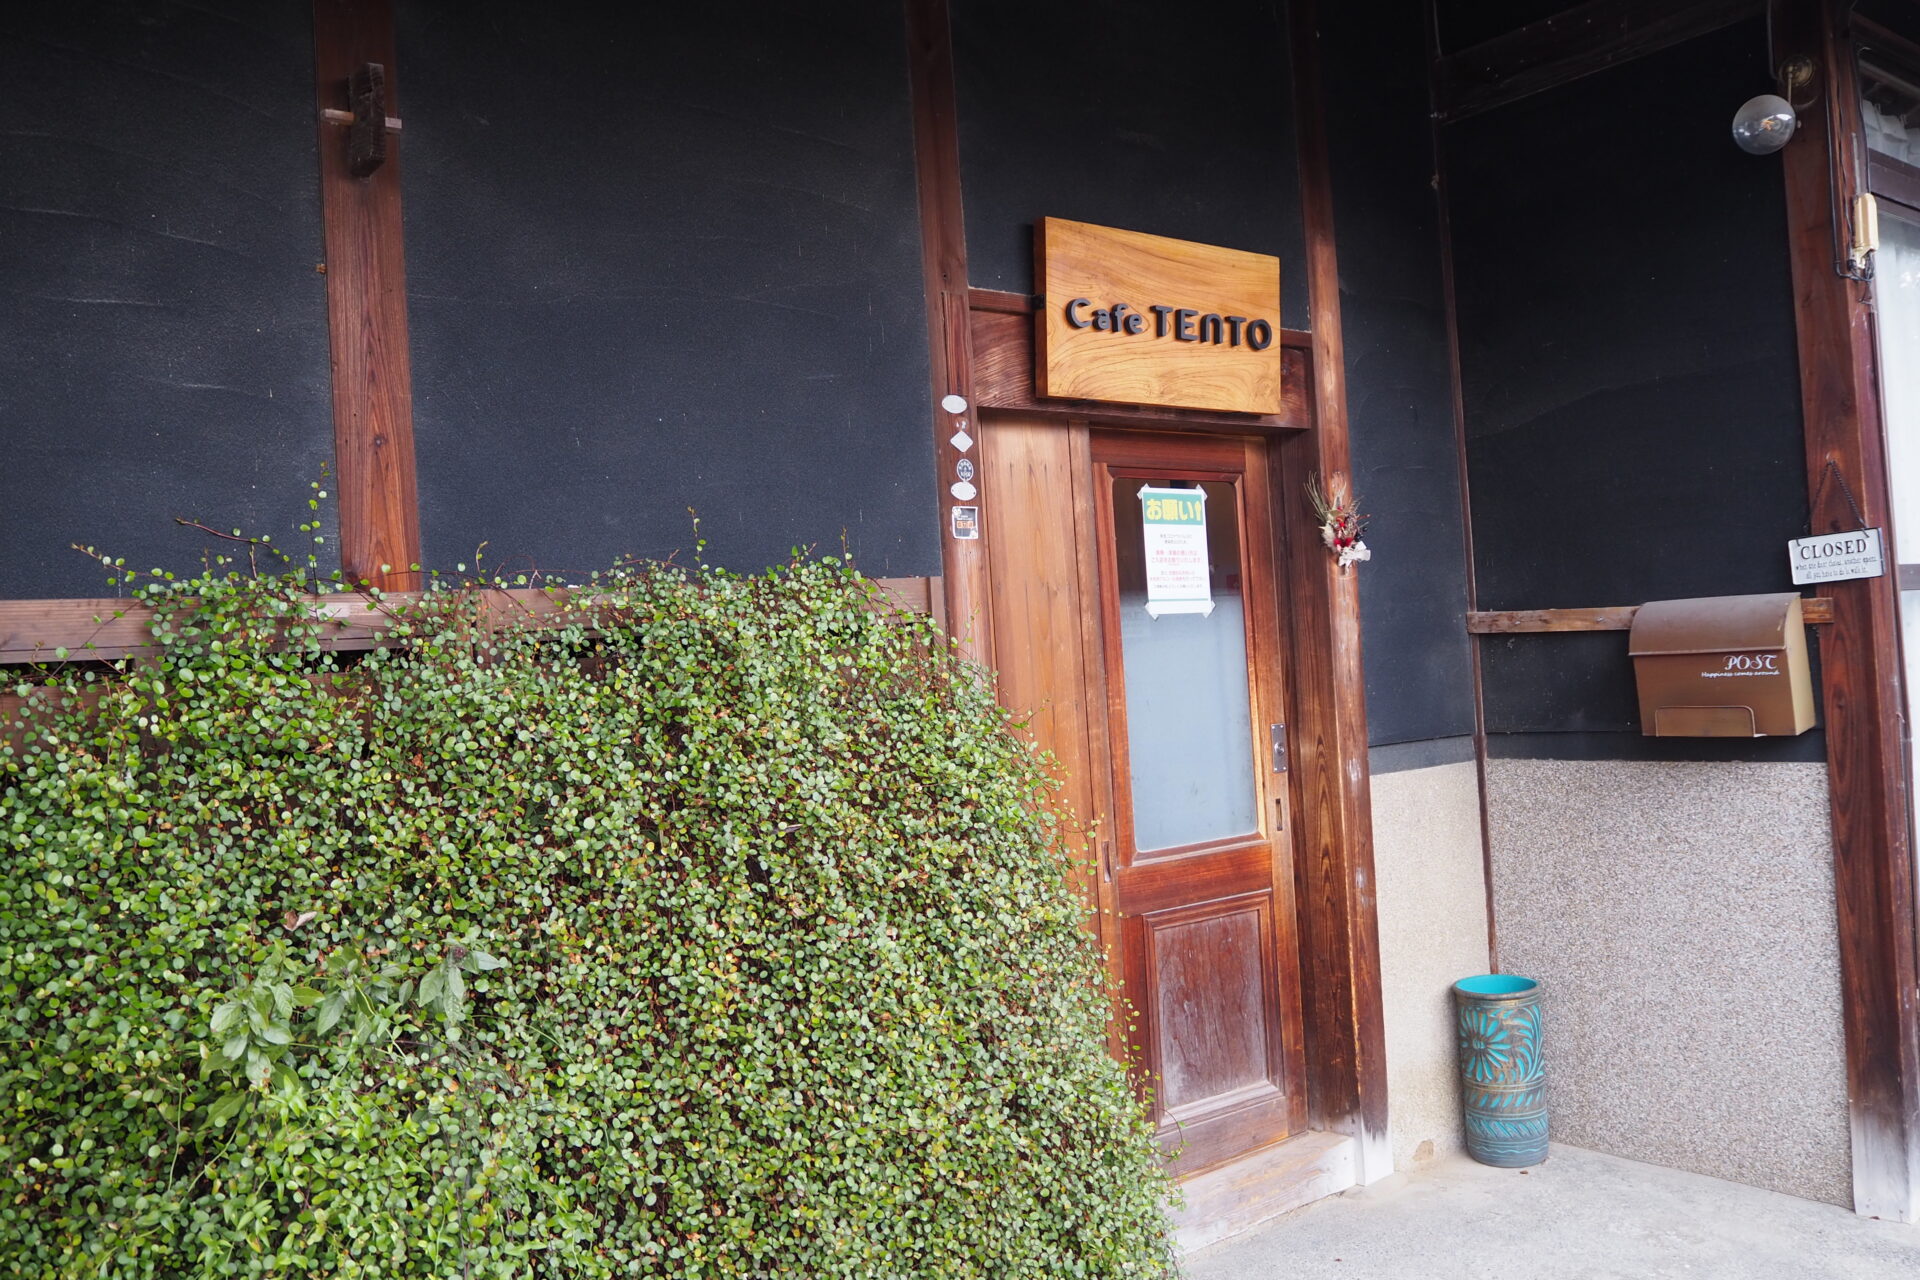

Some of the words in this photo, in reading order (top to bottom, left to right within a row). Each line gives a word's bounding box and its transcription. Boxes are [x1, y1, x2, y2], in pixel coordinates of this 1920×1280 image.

[1066, 298, 1143, 335] Cafe
[1150, 304, 1272, 351] TENTO
[1801, 539, 1866, 559] CLOSED
[1723, 654, 1777, 670] POST
